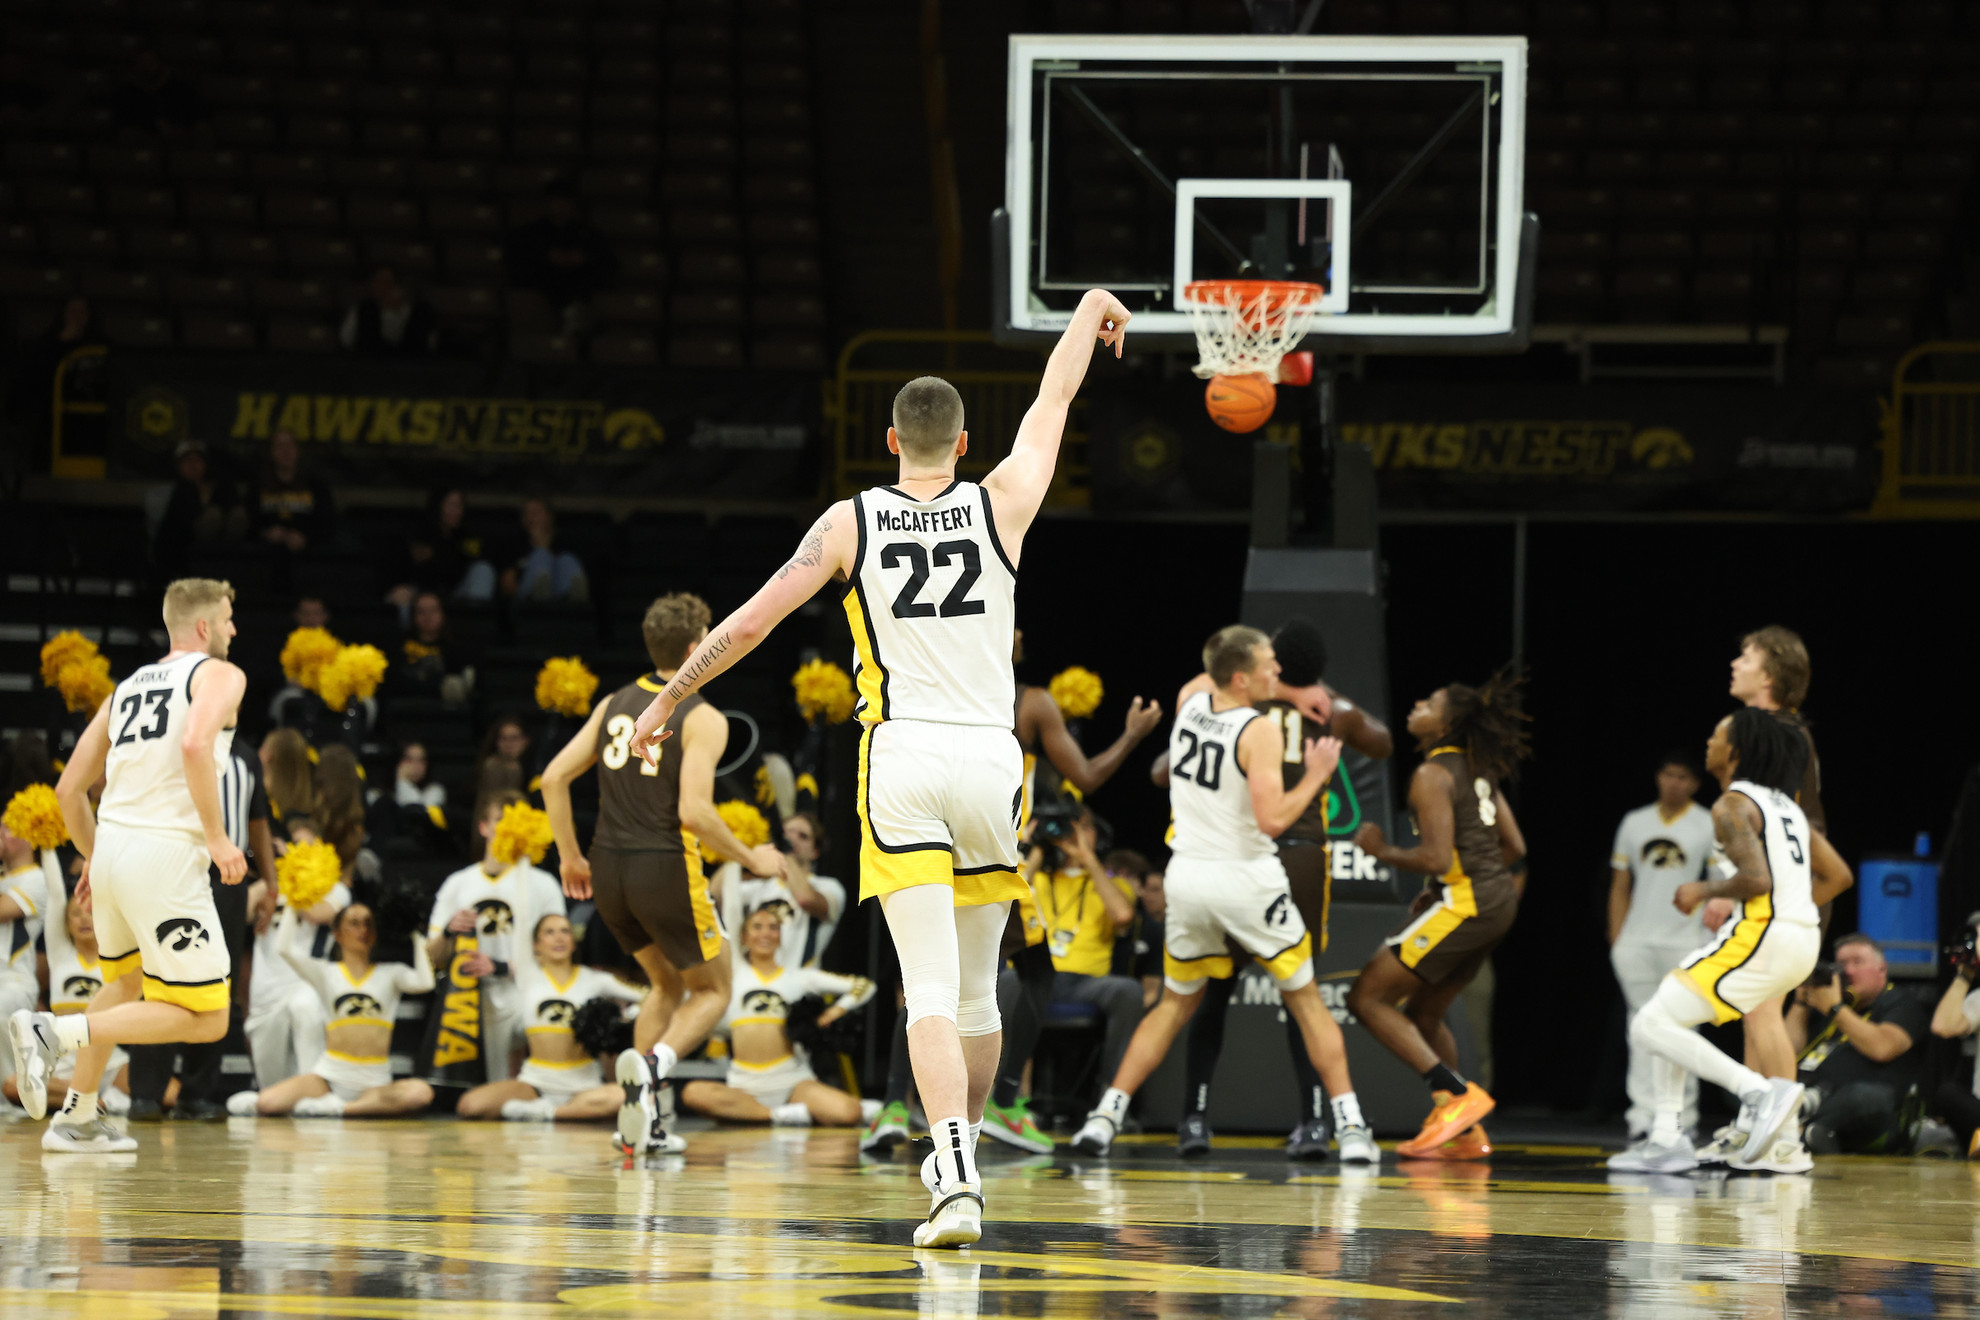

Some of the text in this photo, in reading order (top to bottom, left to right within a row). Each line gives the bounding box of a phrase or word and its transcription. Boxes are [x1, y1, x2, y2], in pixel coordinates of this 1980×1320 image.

[876, 505, 972, 533] McCAFFERY
[880, 539, 986, 619] 22
[695, 631, 732, 673] MMXIV
[115, 688, 174, 748] 23
[1173, 728, 1225, 791] 20
[1780, 816, 1804, 865] 5
[433, 935, 479, 1068] IOWA
